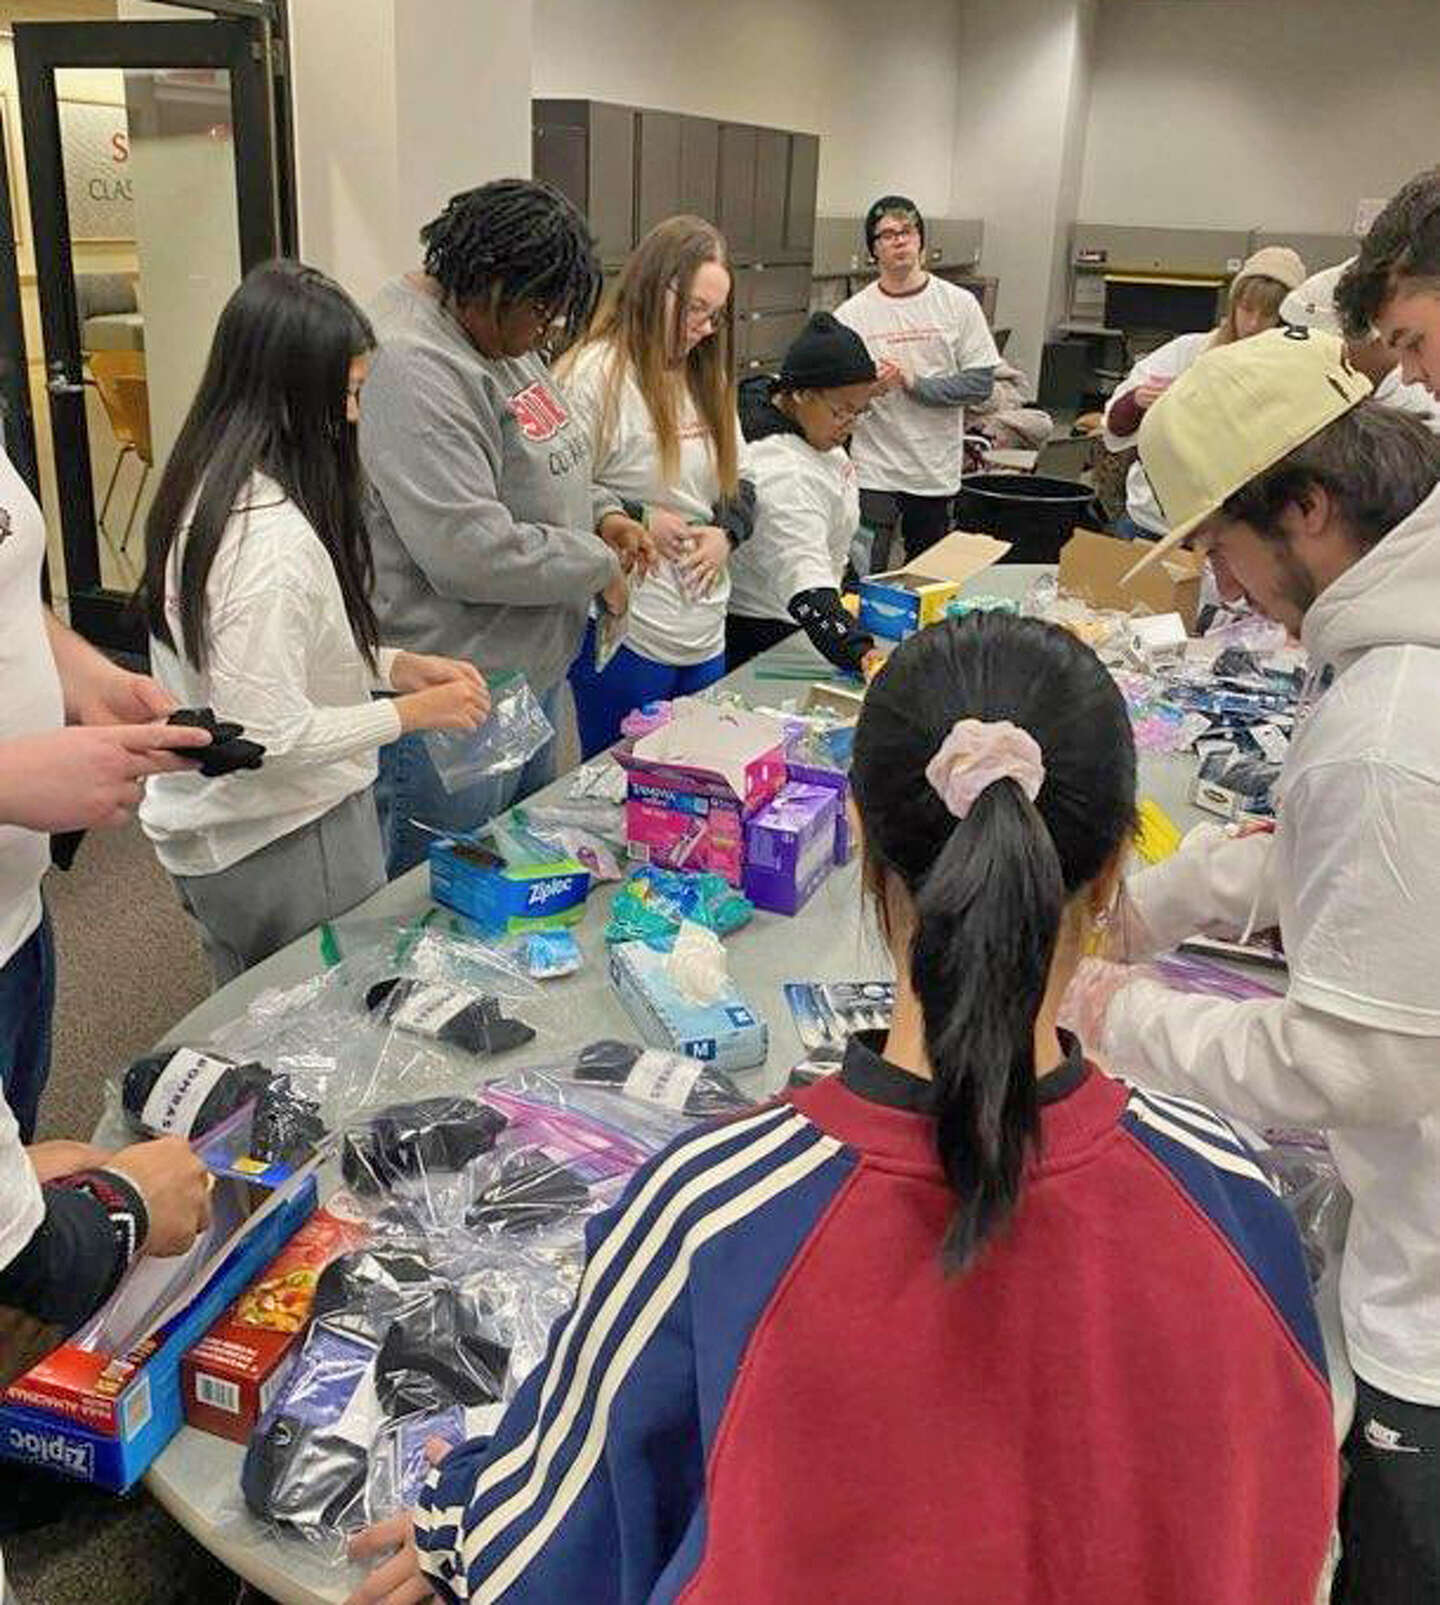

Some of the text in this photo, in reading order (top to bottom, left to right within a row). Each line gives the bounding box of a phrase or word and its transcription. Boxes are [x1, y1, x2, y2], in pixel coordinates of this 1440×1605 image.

[528, 877, 572, 905] Ziploc
[693, 1041, 710, 1057] M
[9, 1427, 89, 1475] Ziploc
